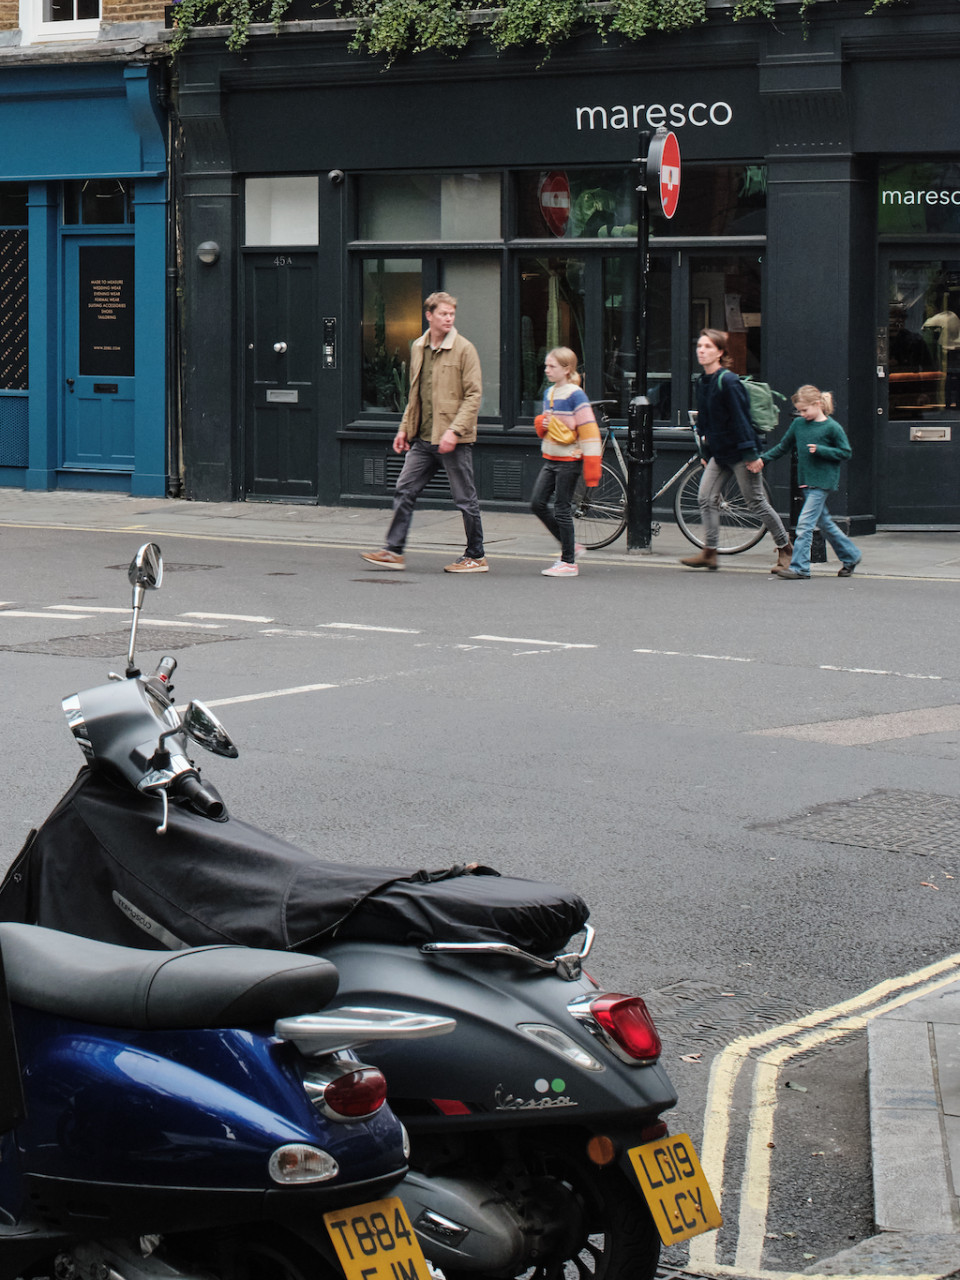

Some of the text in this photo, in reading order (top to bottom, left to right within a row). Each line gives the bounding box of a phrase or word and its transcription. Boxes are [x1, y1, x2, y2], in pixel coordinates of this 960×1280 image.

[575, 101, 733, 130] maresco
[494, 1083, 578, 1110] Vespa
[638, 1142, 695, 1189] LG19
[330, 1208, 412, 1260] T884
[659, 1187, 707, 1235] LCY
